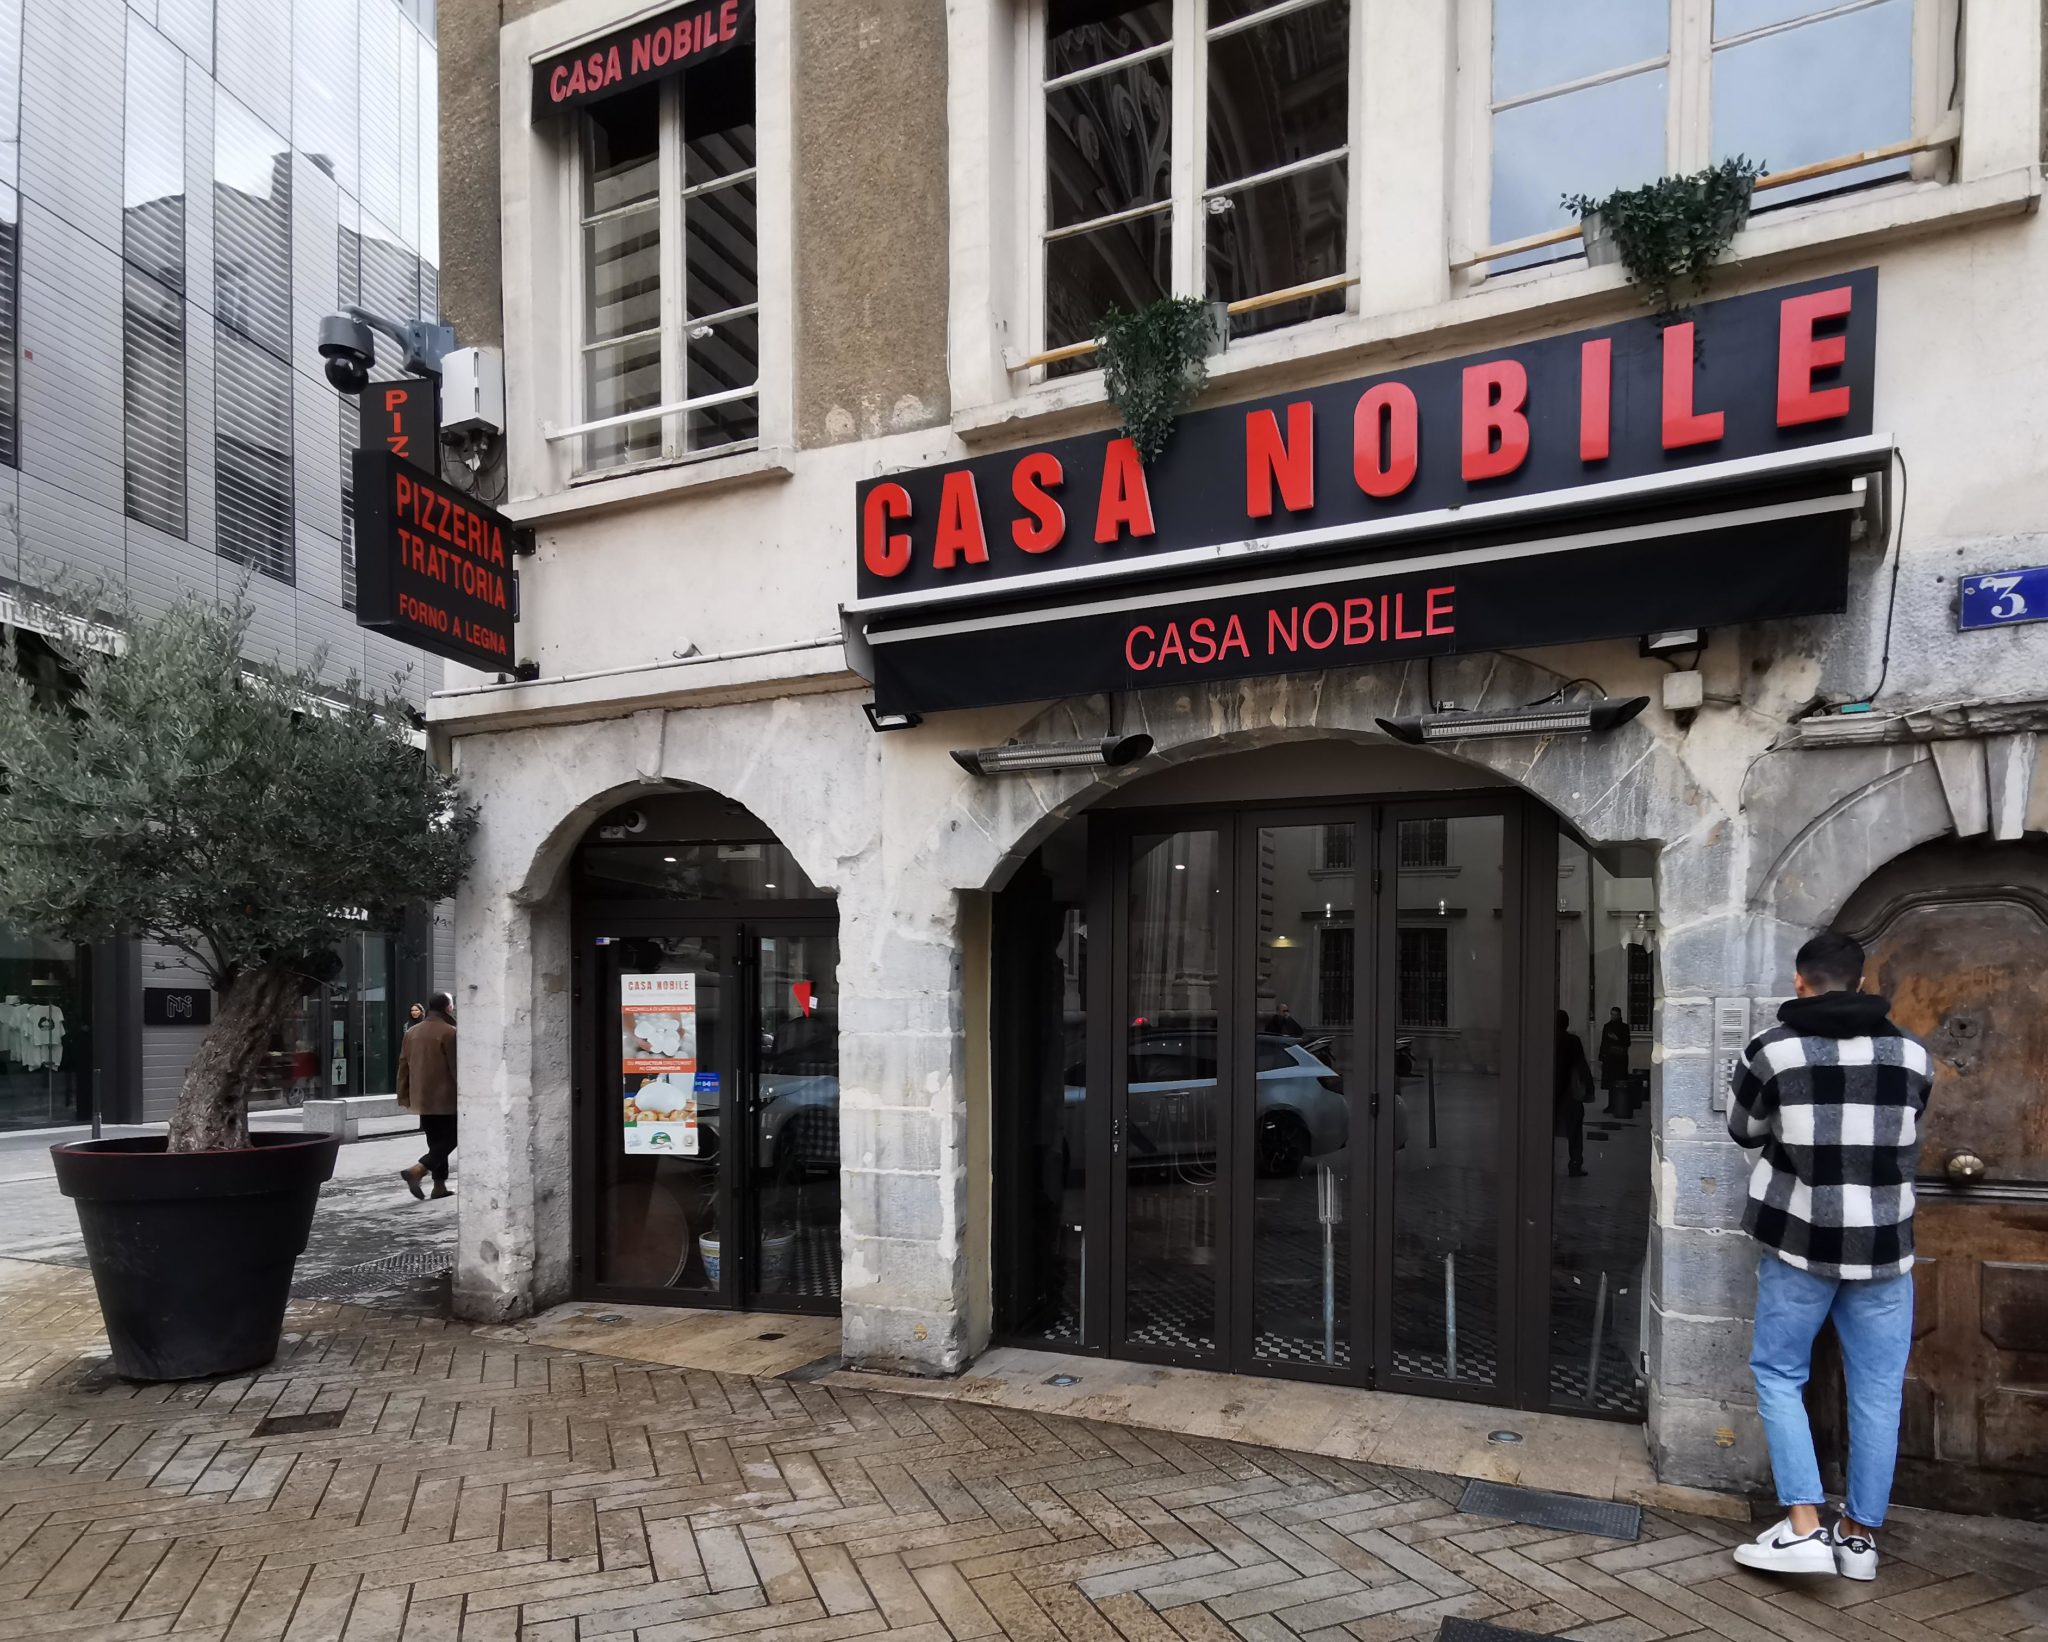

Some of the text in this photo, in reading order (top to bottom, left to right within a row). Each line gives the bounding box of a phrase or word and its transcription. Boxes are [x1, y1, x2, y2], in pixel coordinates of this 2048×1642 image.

[550, 0, 739, 103] CASA NOBILE
[864, 285, 1853, 578] CASA NOBILE
[396, 472, 505, 569] PIZZERIA
[397, 528, 507, 610] TRATTORIA
[1978, 575, 2028, 619] 3
[400, 593, 507, 656] FORNO A LEGNA
[1125, 586, 1456, 671] CASA NOBILE
[628, 980, 689, 991] CASA NOBILE
